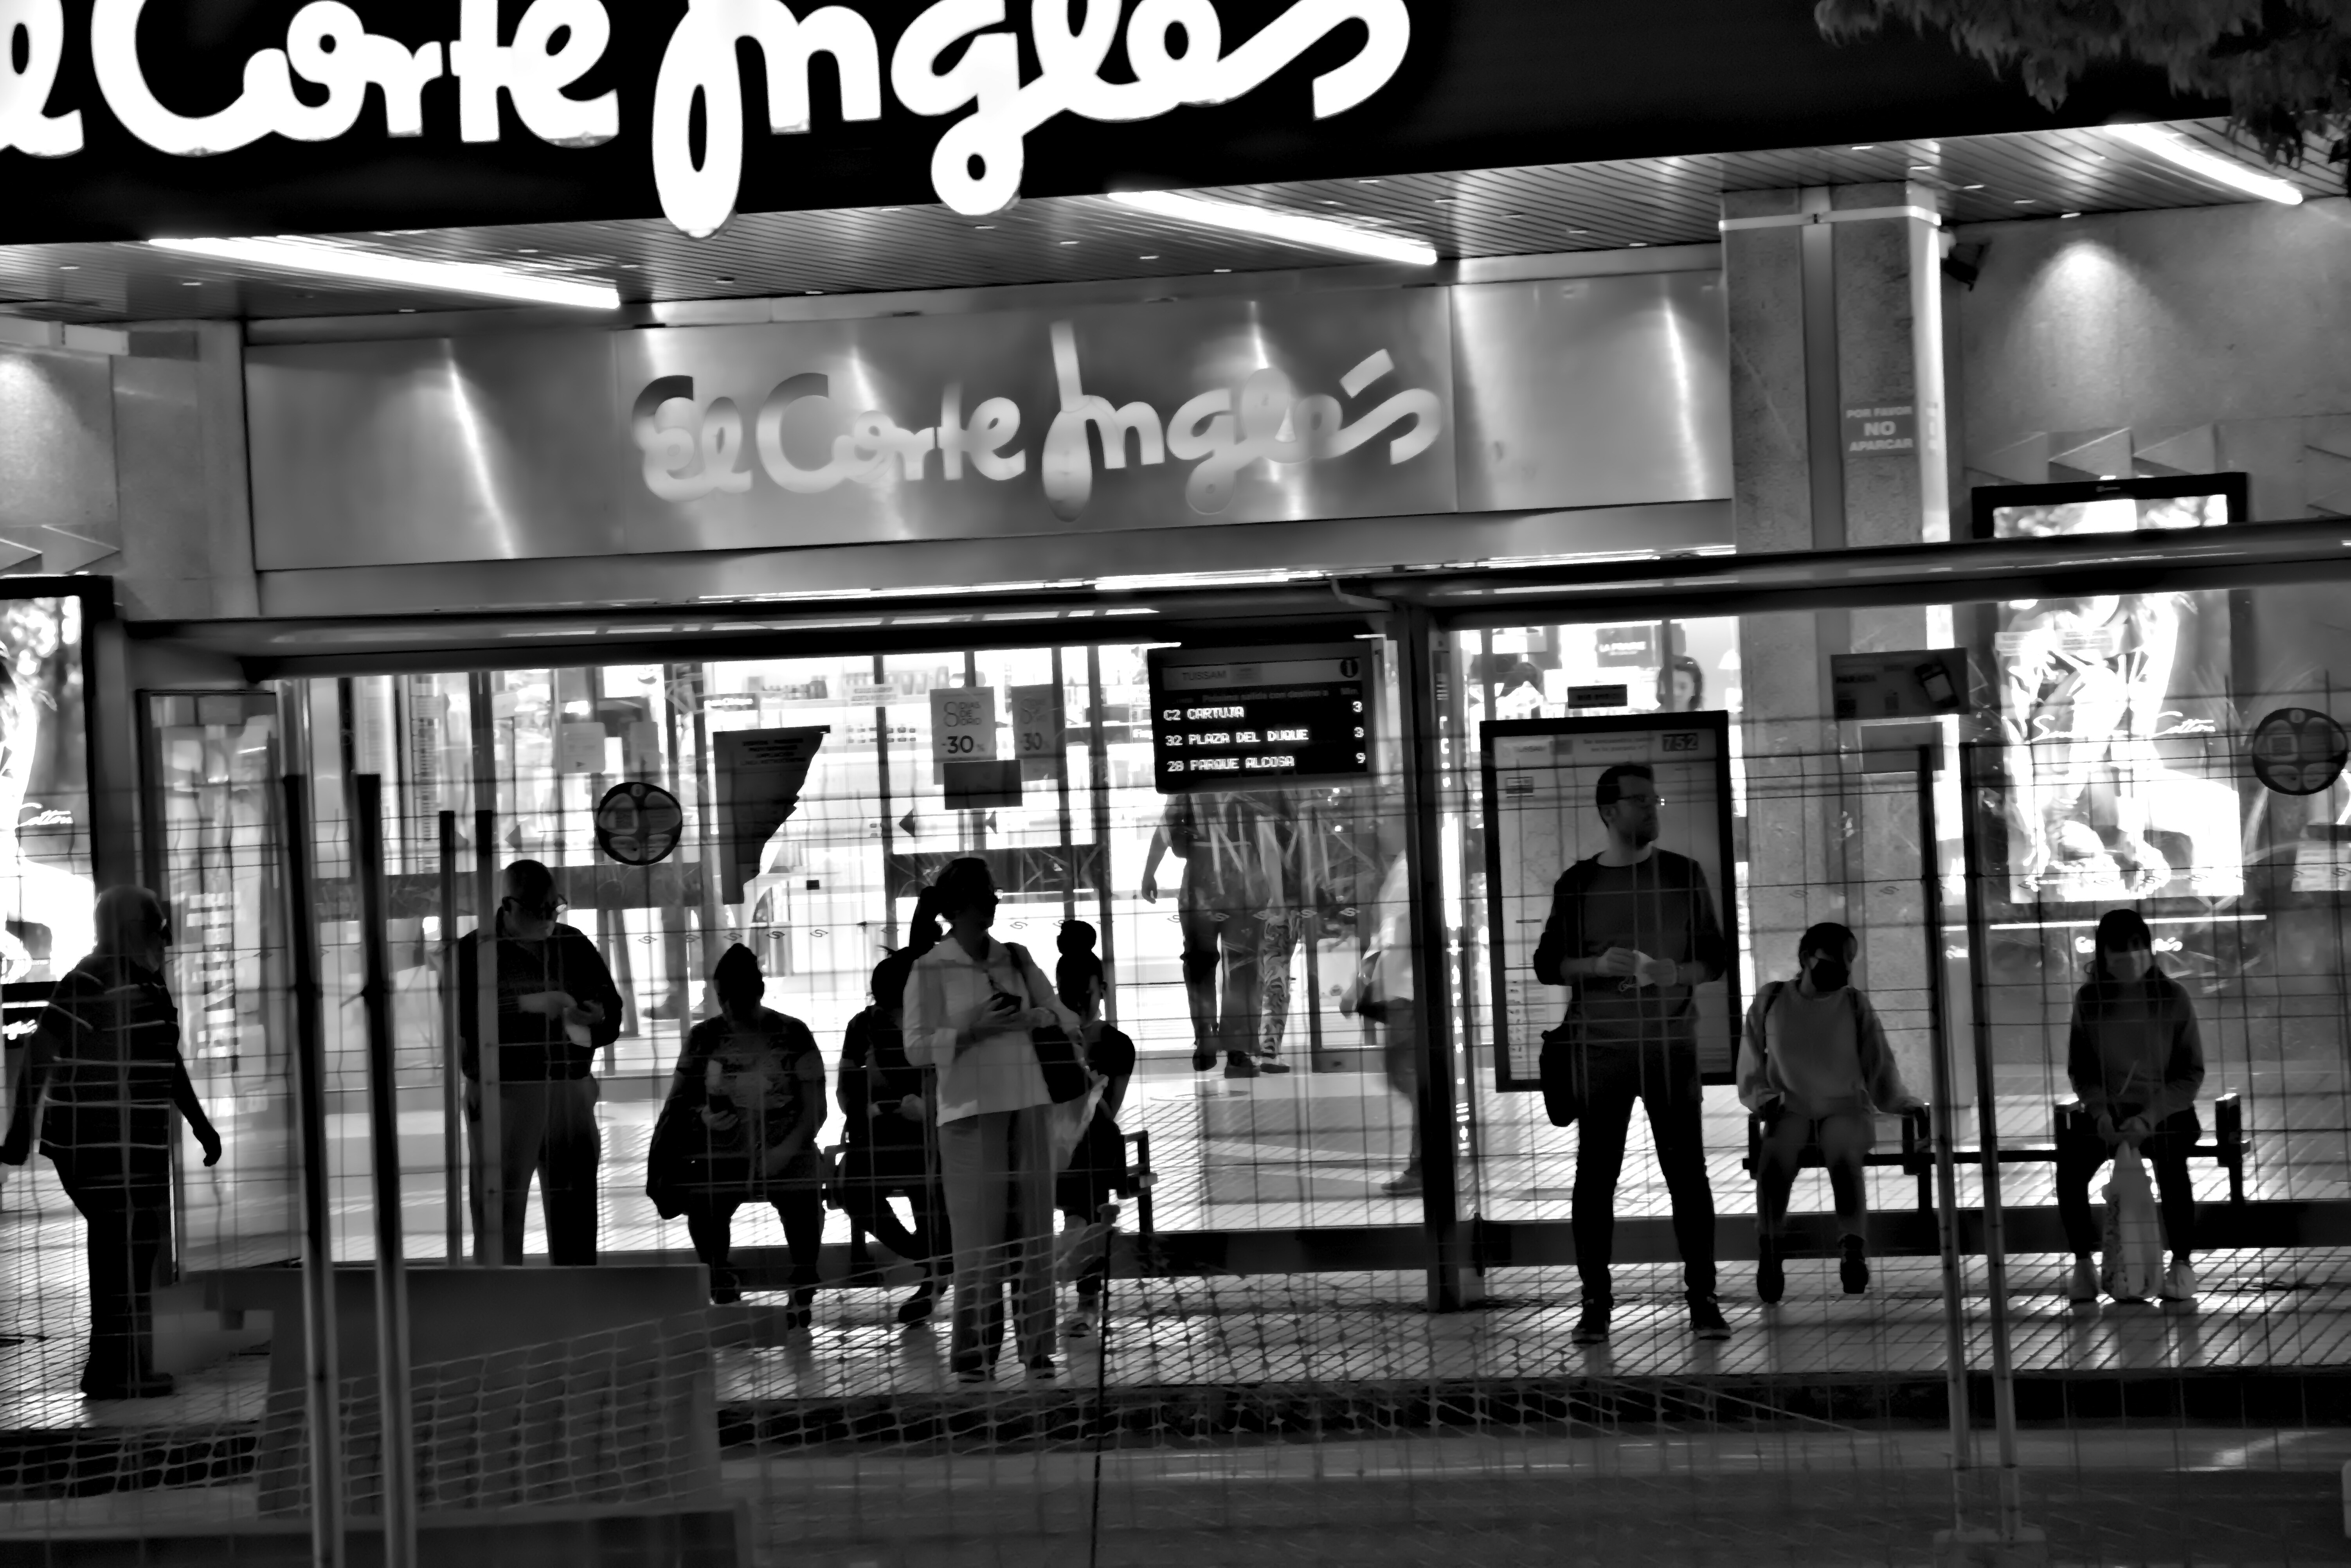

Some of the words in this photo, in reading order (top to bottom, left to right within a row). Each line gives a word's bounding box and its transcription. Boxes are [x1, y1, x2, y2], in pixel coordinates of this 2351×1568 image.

[91, 0, 619, 156] Corte
[1864, 421, 1896, 436] NO
[631, 374, 752, 503] El
[755, 372, 1026, 495] Corte
[1849, 438, 1913, 451] APARCAR
[1182, 670, 1227, 680] TUSSAM
[943, 701, 960, 727] 8
[1163, 710, 1181, 721] C2
[1187, 706, 1244, 720] CARTUJA
[1352, 701, 1363, 712] 3
[1165, 735, 1183, 746] 32
[1188, 733, 1230, 745] PLAZA
[1236, 732, 1261, 743] DEL
[1267, 729, 1309, 741] DUQUE
[1354, 726, 1364, 738] 3
[1664, 734, 1697, 750] 752
[1190, 758, 1240, 771] PARQUE
[1245, 756, 1295, 768] ALCOSA
[1356, 752, 1366, 763] 9
